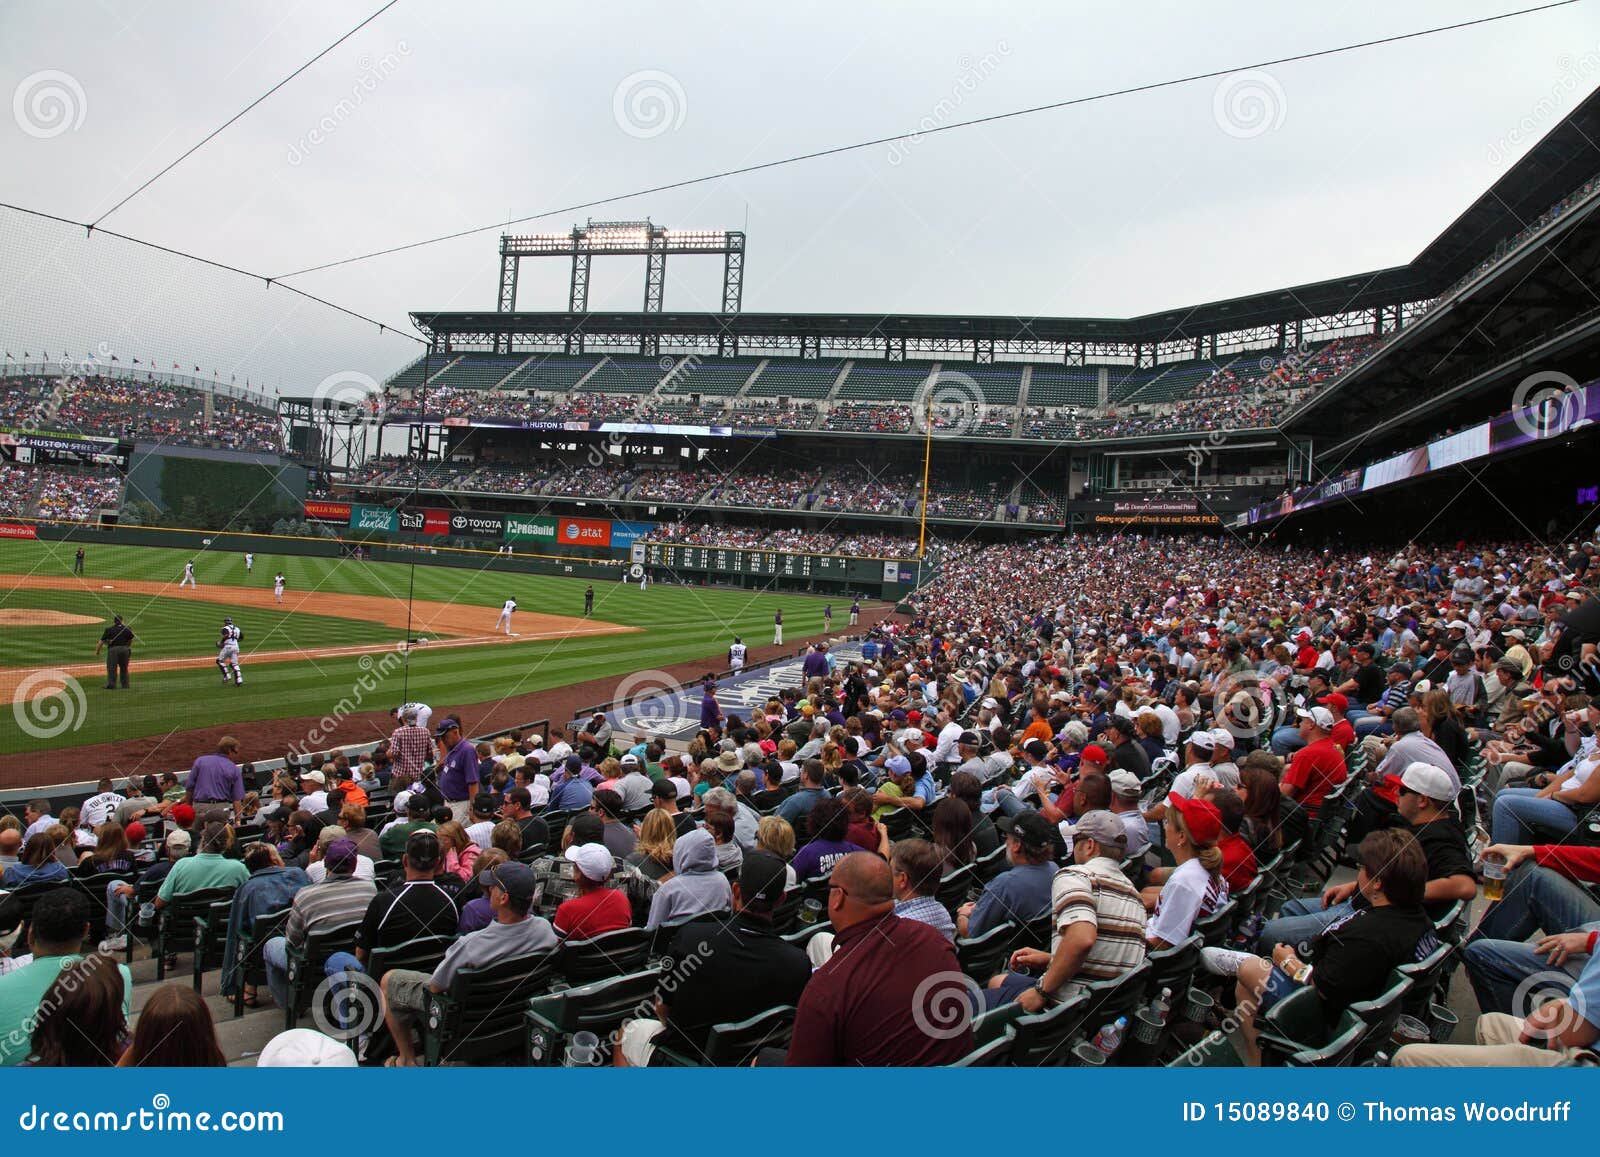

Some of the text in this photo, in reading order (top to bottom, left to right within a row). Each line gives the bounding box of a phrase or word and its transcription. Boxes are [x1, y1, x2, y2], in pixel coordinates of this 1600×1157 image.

[30, 438, 68, 449] HUSTON
[469, 519, 502, 529] TOYOTA
[582, 526, 602, 538] at&t
